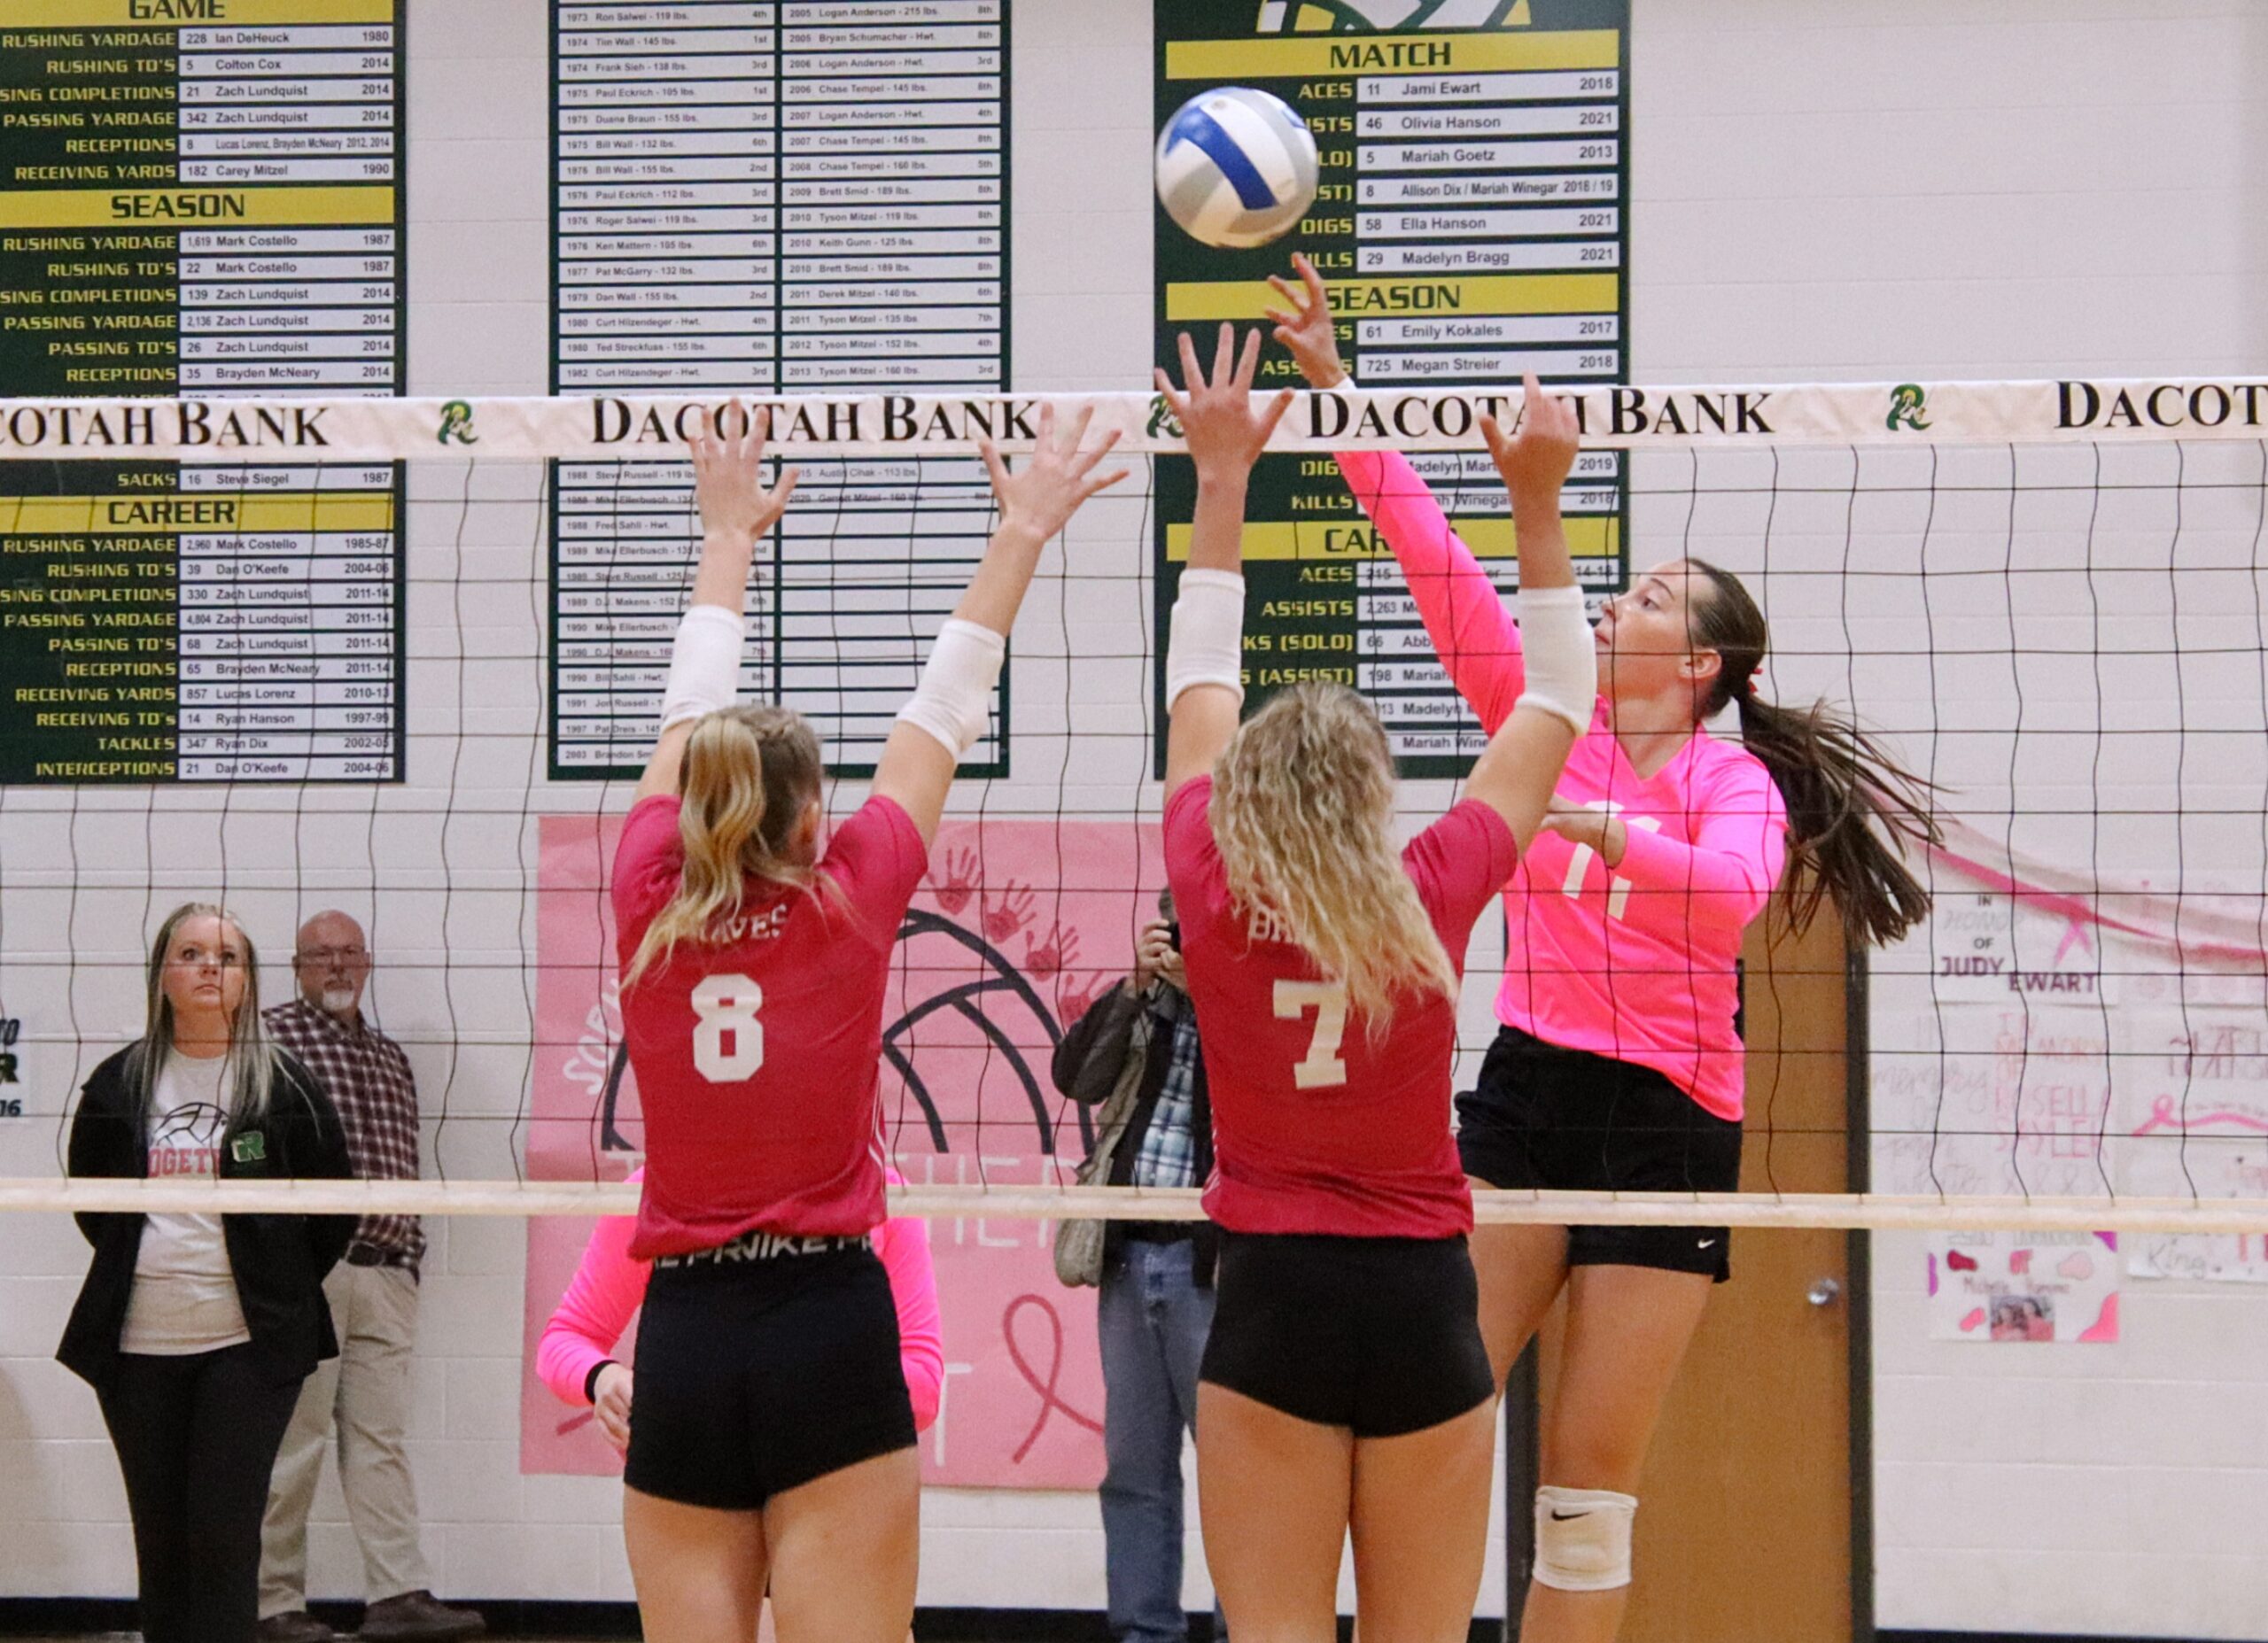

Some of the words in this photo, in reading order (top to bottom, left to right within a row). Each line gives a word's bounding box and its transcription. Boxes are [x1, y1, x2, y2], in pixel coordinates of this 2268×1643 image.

[129, 0, 225, 19] GAME
[850, 8, 895, 17] Anderson
[4, 34, 83, 46] RUSHING
[91, 34, 175, 45] YARDAGE
[186, 34, 206, 43] 228
[363, 31, 389, 41] 1980
[1330, 43, 1451, 69] MATCH
[47, 60, 128, 73] RUSHING
[187, 60, 193, 70] 5
[216, 59, 254, 69] Colton
[259, 59, 281, 69] Cox
[362, 57, 389, 68] 2014
[187, 88, 199, 97] 21
[216, 86, 245, 97] Zach
[248, 85, 307, 98] Lundquist
[1299, 84, 1352, 98] ACES
[1369, 84, 1380, 96] 11
[1402, 82, 1436, 96] Jami
[1441, 81, 1480, 95] Ewart
[1580, 78, 1612, 90] 2018
[50, 88, 175, 100] COMPLETIONS
[4, 113, 83, 126] PASSING
[187, 113, 206, 123] 342
[1366, 118, 1382, 129] 46
[1402, 116, 1442, 129] Olivia
[1448, 116, 1501, 128] Hanson
[1580, 112, 1612, 125] 2021
[66, 139, 175, 152] RECEPTIONS
[1367, 152, 1374, 163] 5
[1402, 150, 1448, 163] Mariah
[1453, 149, 1495, 161] Goetz
[1580, 146, 1612, 159] 2013
[15, 167, 108, 179] RECEIVING
[116, 167, 175, 178] YARDS
[188, 167, 206, 175] 182
[216, 166, 250, 178] Carey
[254, 165, 287, 175] Mitzel
[363, 164, 389, 174] 1990
[1402, 183, 1441, 196] Allison
[112, 195, 245, 218] SEASON
[1301, 219, 1352, 234] DIGS
[1366, 219, 1381, 230] 58
[1402, 217, 1426, 229] Ella
[1432, 217, 1486, 229] Hanson
[1580, 214, 1612, 227] 2021
[217, 236, 245, 246] Mark
[249, 236, 297, 246] Costello
[364, 235, 390, 244] 1987
[1292, 252, 1352, 268] ILLS
[1367, 253, 1383, 265] 29
[1403, 251, 1461, 267] Madelyn
[1466, 252, 1509, 267] Bragg
[1581, 249, 1613, 261] 2021
[49, 264, 128, 276] RUSHING
[50, 290, 175, 302] COMPLETIONS
[189, 290, 207, 299] 139
[216, 289, 245, 299] Zach
[249, 289, 308, 301] Lundquist
[1324, 286, 1460, 312] SEASON
[1367, 326, 1381, 337] 61
[1402, 324, 1441, 339] Emily
[1446, 323, 1503, 337] Kokales
[1580, 322, 1612, 334] 2017
[50, 343, 128, 354] PASSING
[188, 342, 200, 353] 26
[1367, 360, 1391, 371] 725
[1402, 359, 1449, 374] Megan
[1580, 355, 1612, 368] 2018
[187, 368, 200, 378] 35
[216, 368, 265, 379] Brayden
[269, 367, 320, 379] McNeary
[1609, 388, 1775, 435] BANK
[0, 406, 155, 446] OTAH
[178, 401, 329, 446] BANK
[882, 397, 1038, 442] BANK
[1580, 459, 1612, 470] 2019
[119, 473, 175, 485] SACKS
[189, 475, 200, 484] 16
[216, 474, 248, 484] Steve
[253, 473, 289, 485] Siegel
[363, 473, 389, 483] 1987
[1293, 496, 1352, 509] KILLS
[109, 501, 235, 524] CAREER
[1301, 567, 1352, 582] ACES
[1262, 601, 1353, 616] ASSISTS
[67, 663, 175, 676] RECEPTIONS
[187, 689, 207, 699] 857
[216, 688, 252, 699] Lucas
[255, 688, 295, 698] Lorenz
[188, 714, 200, 724] 14
[216, 714, 245, 725] Ryan
[249, 713, 294, 724] Hanson
[99, 738, 175, 750] TACKLES
[186, 739, 206, 748] 347
[216, 739, 245, 751] Ryan
[248, 738, 268, 748] Dix
[1403, 736, 1450, 748] Mariah
[36, 763, 175, 775] INTERCEPTIONS
[187, 763, 198, 773] 21
[216, 763, 238, 773] Dan
[1974, 938, 1993, 949] OF
[1941, 957, 2004, 977] JUDY
[2008, 973, 2096, 992] EWART
[691, 973, 764, 1082] 8
[1272, 979, 1348, 1089] 7
